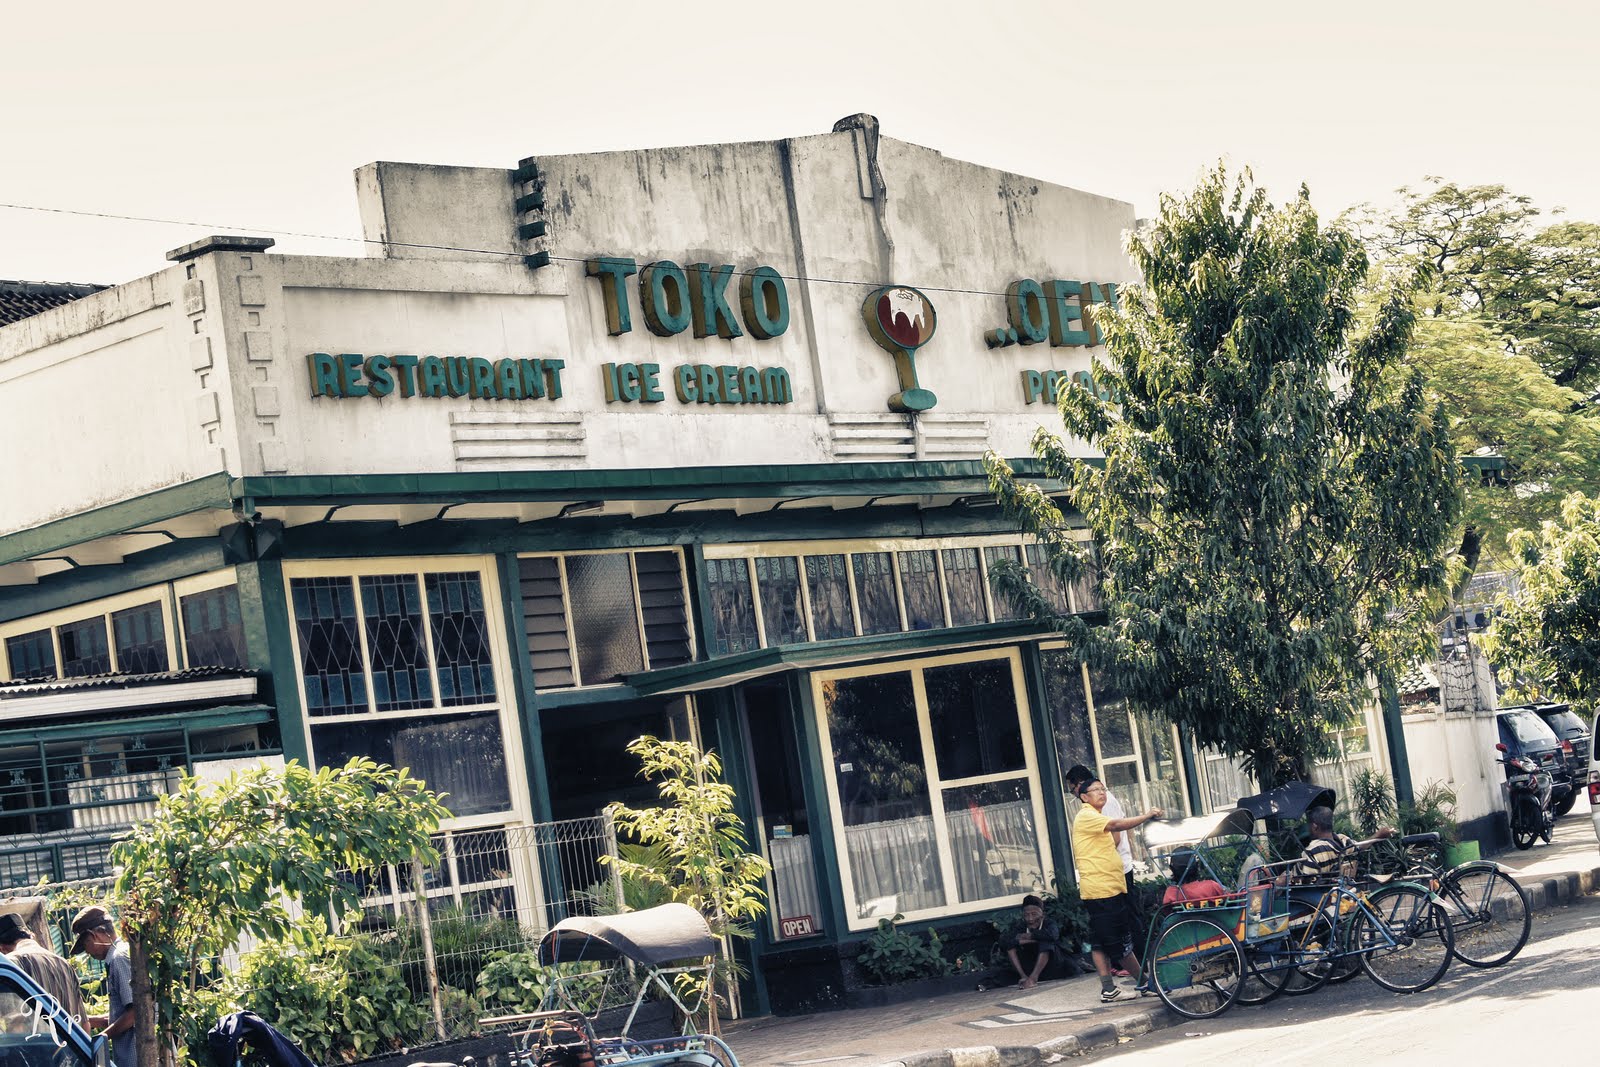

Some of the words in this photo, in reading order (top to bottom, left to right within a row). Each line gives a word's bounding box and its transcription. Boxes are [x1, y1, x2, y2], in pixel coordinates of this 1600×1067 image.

[586, 257, 791, 340] TOKO
[306, 352, 566, 401] RESTAURANT
[602, 362, 665, 402] ICE
[673, 363, 793, 405] CREAM
[783, 918, 812, 936] OPEN
